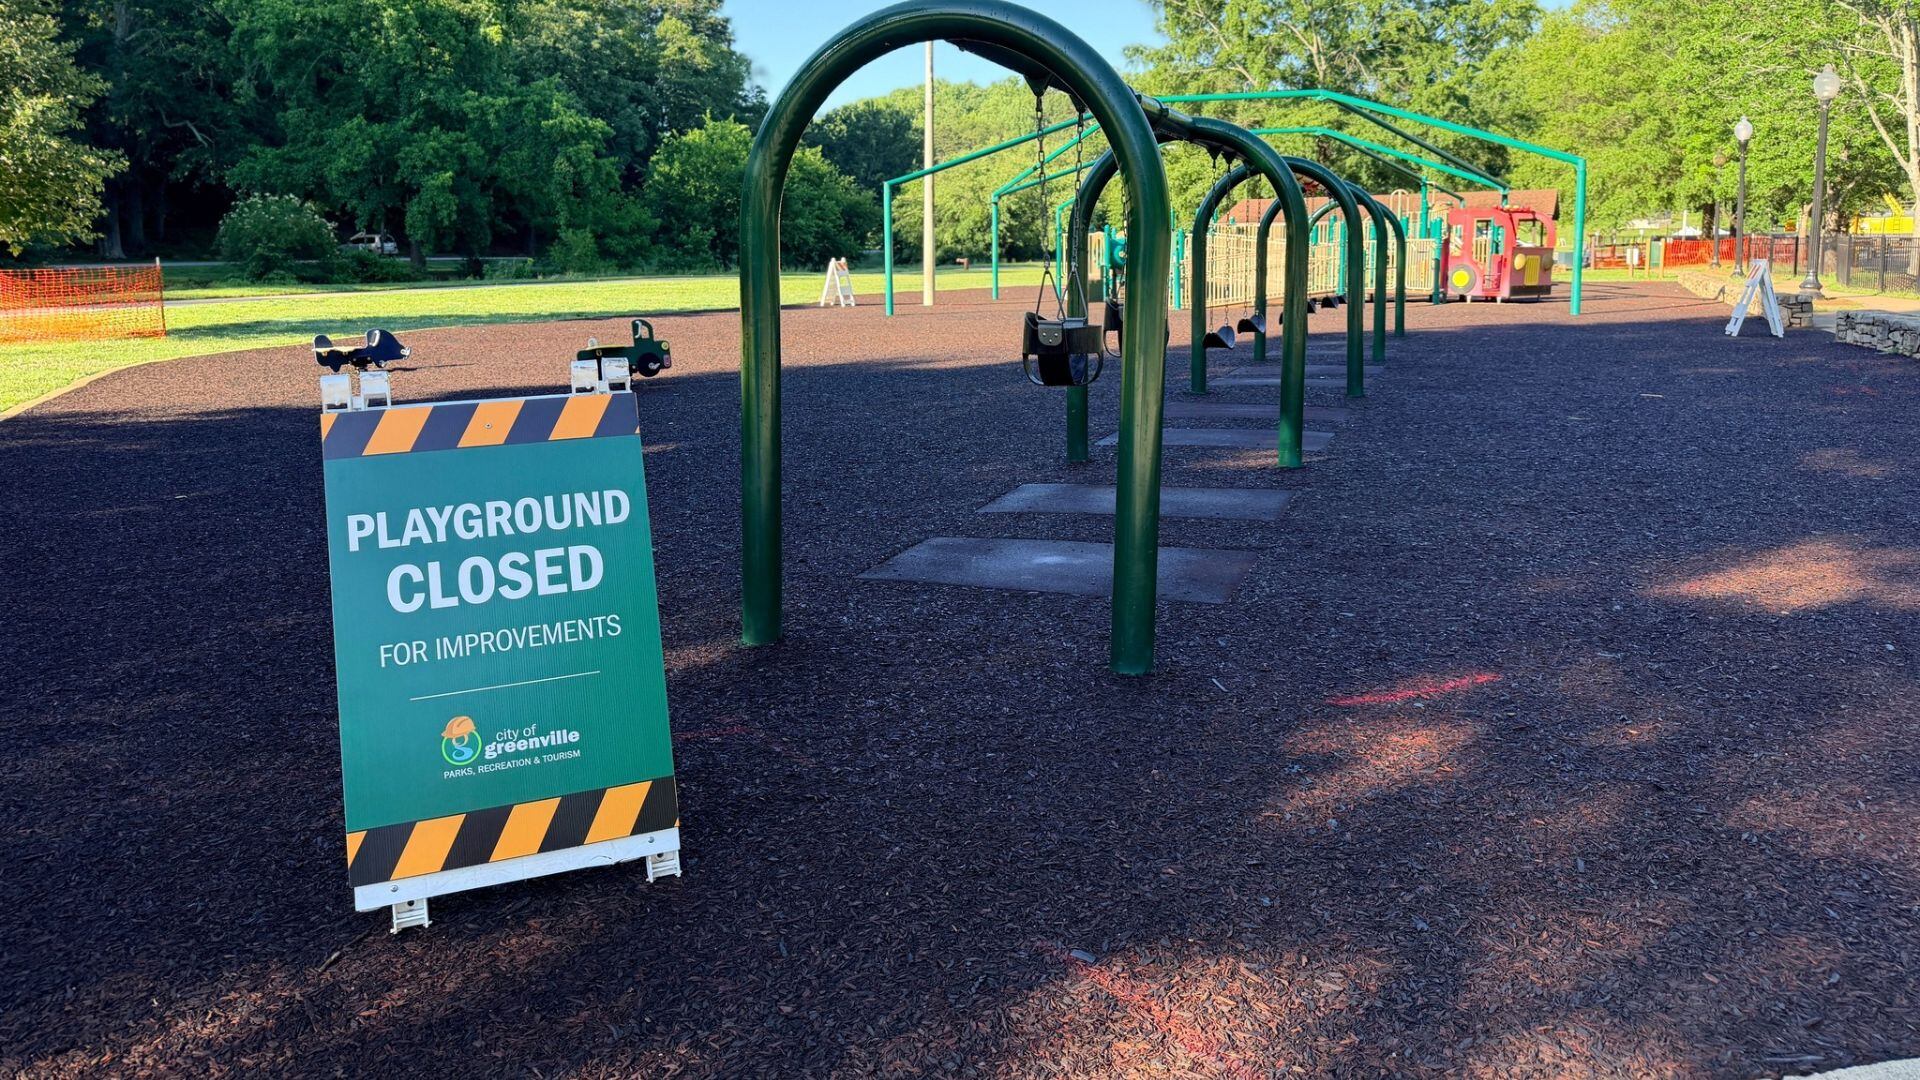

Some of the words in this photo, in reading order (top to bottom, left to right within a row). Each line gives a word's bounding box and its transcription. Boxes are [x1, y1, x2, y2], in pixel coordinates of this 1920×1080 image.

[347, 489, 630, 552] PLAYGROUND
[386, 544, 604, 613] CLOSED
[379, 640, 428, 667] FOR
[435, 614, 622, 660] IMPROVEMENTS
[484, 729, 580, 760] greenville
[496, 728, 519, 741] city
[523, 724, 537, 737] of
[443, 767, 476, 779] PARKS,
[478, 758, 531, 774] RECREATION
[533, 756, 541, 765] &
[542, 749, 581, 763] TOURISM
